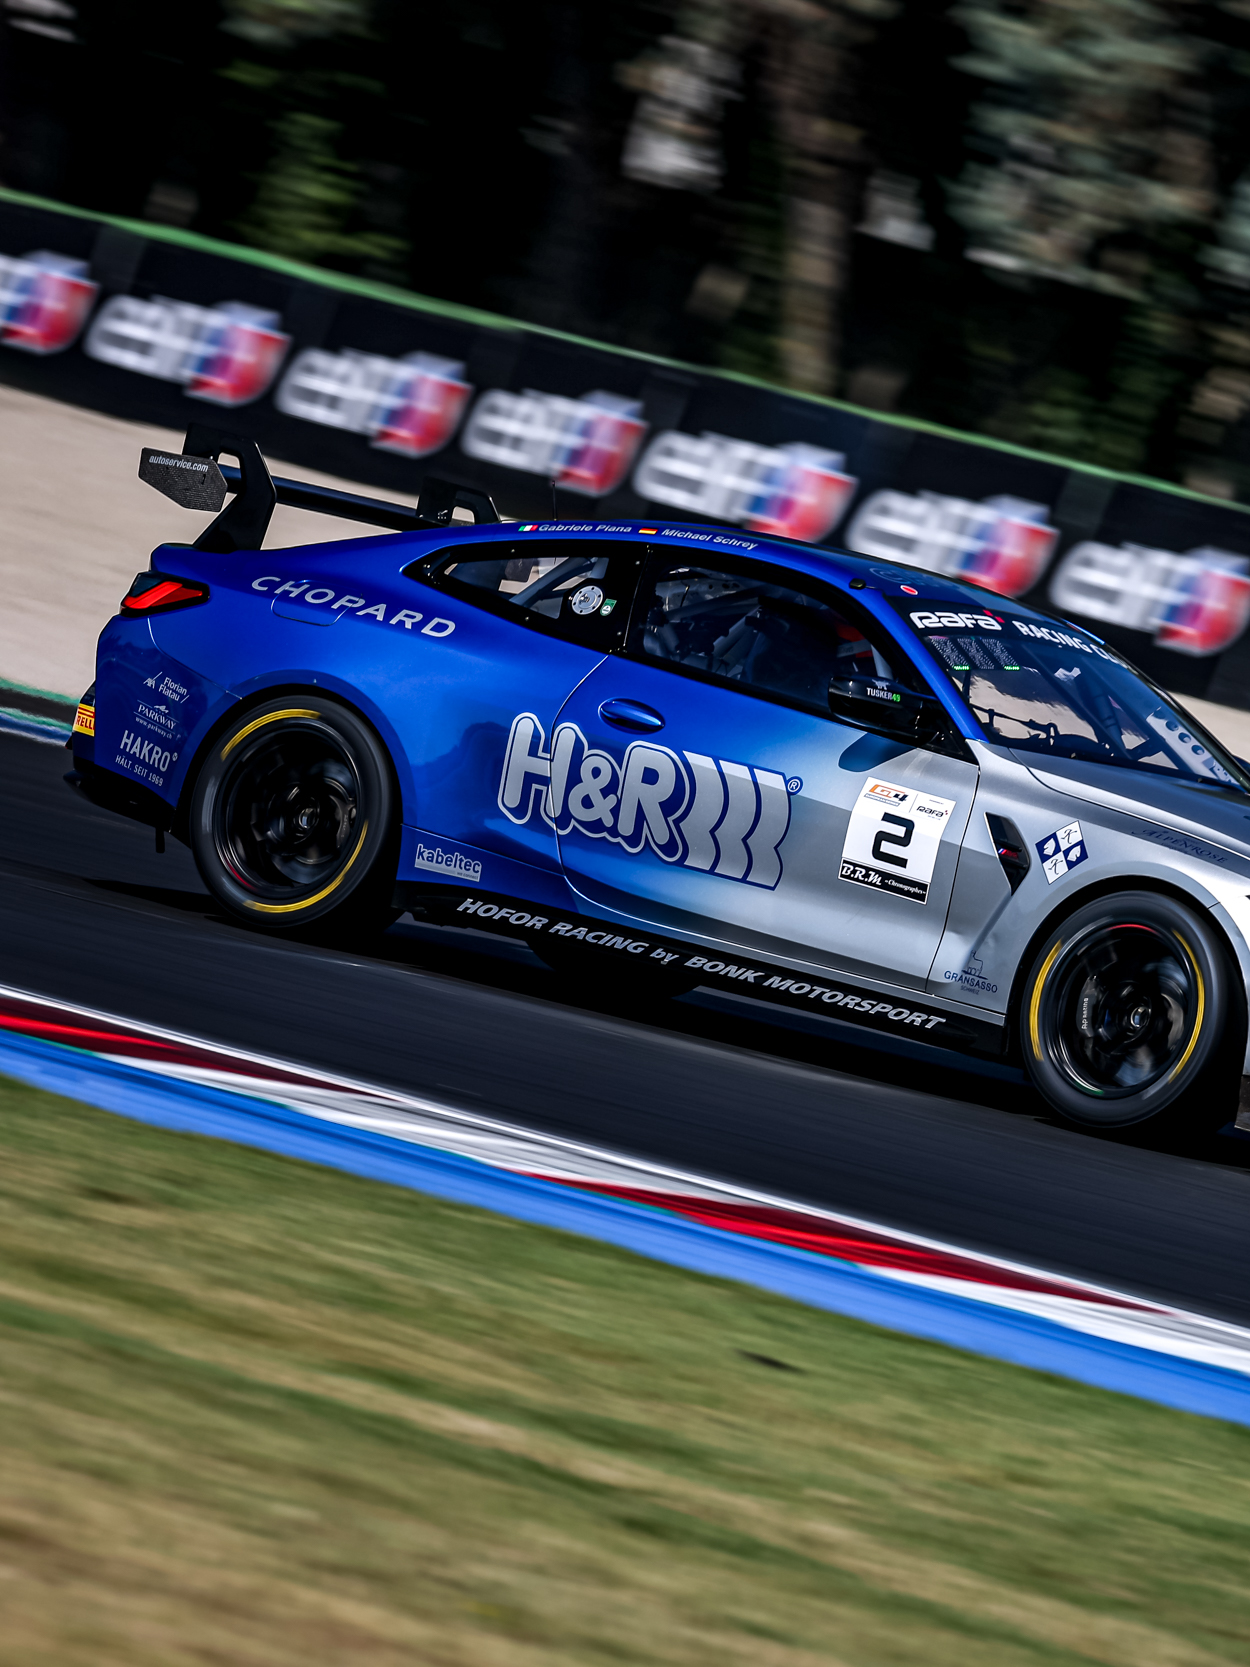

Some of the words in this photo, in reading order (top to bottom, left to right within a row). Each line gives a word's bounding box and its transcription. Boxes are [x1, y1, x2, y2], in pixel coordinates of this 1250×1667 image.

[149, 455, 208, 472] autoservice.com
[538, 524, 597, 533] Gabriele
[661, 528, 712, 542] Michael
[713, 535, 758, 550] Schrey
[251, 576, 456, 638] CHOPARD
[1012, 620, 1093, 654] RACING
[158, 683, 180, 702] Flatau
[163, 677, 188, 696] Florian
[135, 716, 173, 740] www.parkway.ch
[138, 704, 177, 730] PARKWAY
[133, 764, 148, 778] SEIT
[148, 772, 164, 787] 1969
[871, 812, 915, 869] 2
[416, 843, 481, 874] kabeltec
[456, 898, 549, 930] HOFOR
[548, 922, 650, 954] RACING
[649, 947, 680, 966] by
[684, 955, 765, 984] BONK
[762, 975, 947, 1030] MOTORSPORT
[944, 970, 998, 994] GRANSASSO
